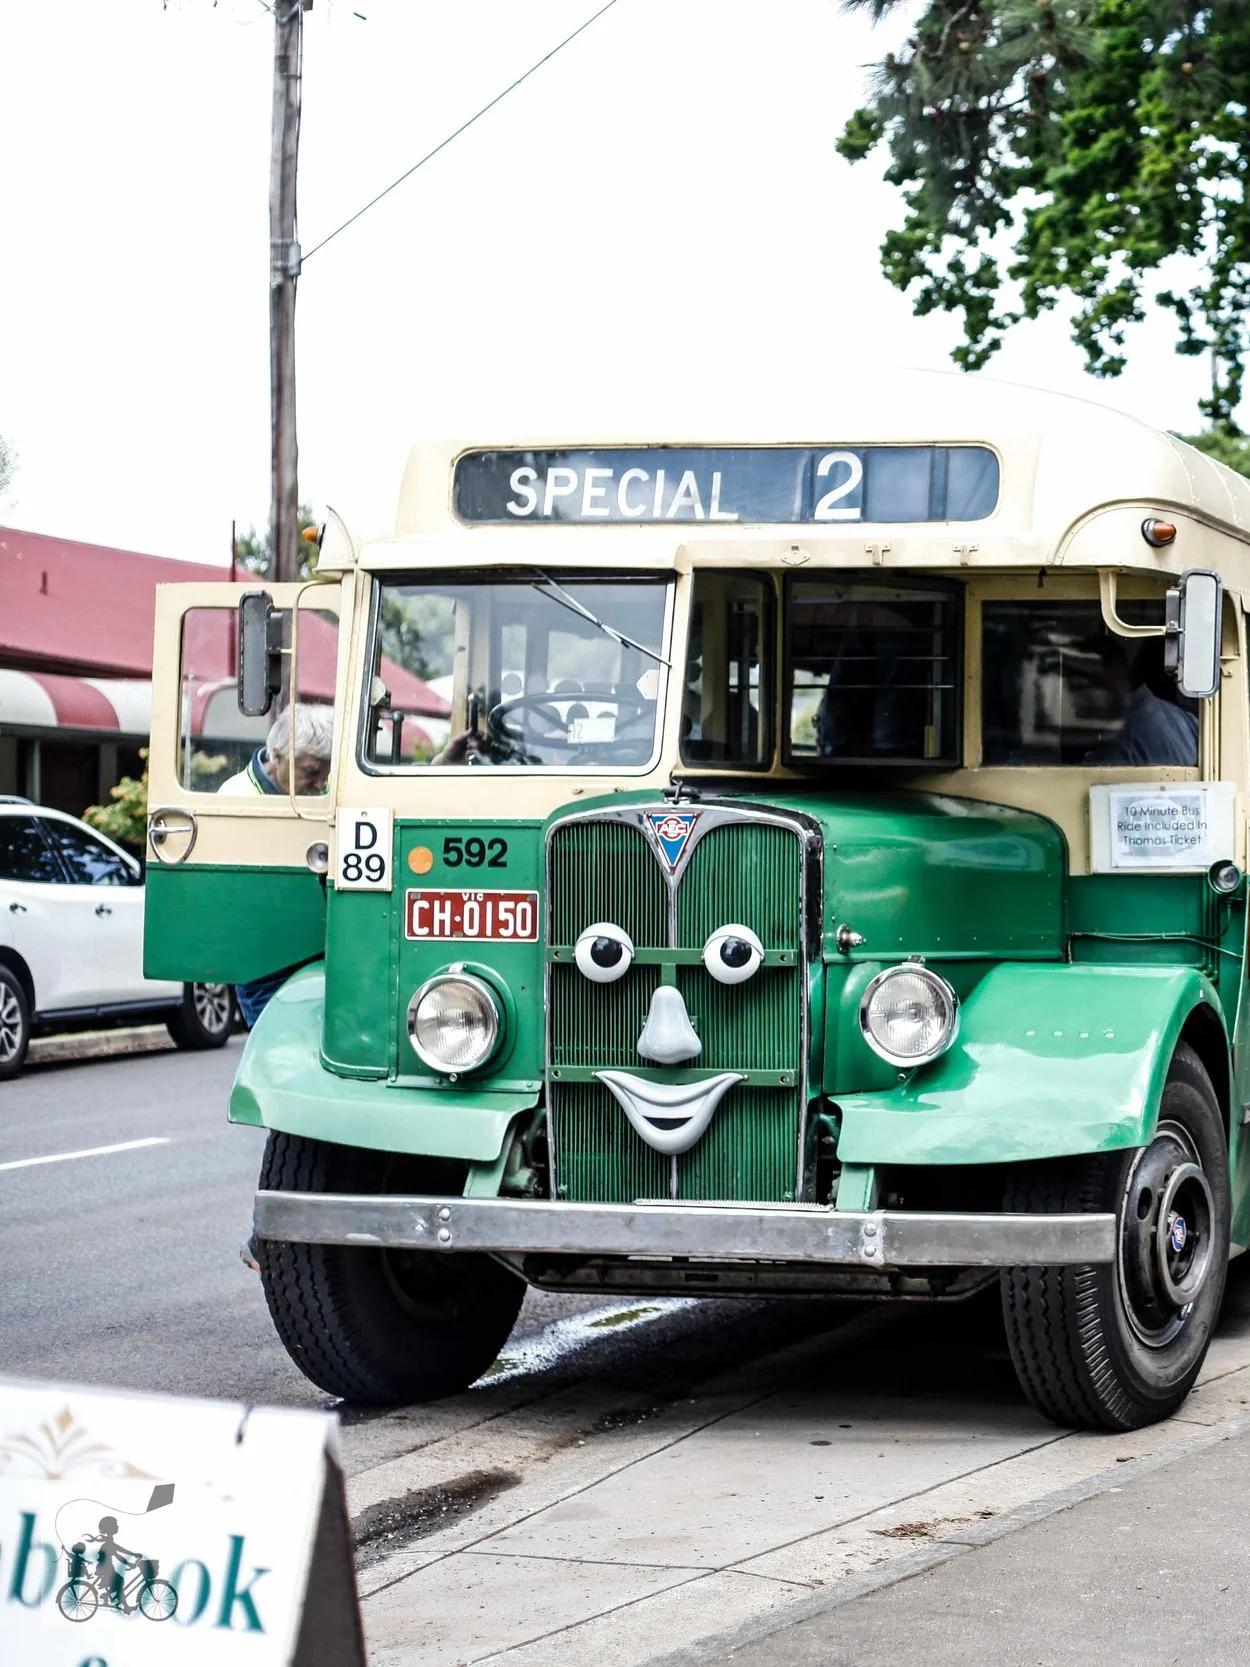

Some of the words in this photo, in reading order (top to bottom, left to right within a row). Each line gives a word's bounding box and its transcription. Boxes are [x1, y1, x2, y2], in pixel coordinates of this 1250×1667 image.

[506, 467, 739, 520] SPECIAL
[813, 451, 864, 520] 2
[1124, 806, 1137, 817] 10
[1139, 806, 1178, 816] Minute
[1181, 805, 1200, 816] Bus
[354, 821, 378, 850] D
[658, 823, 688, 834] AEC
[1117, 821, 1141, 832] Ride
[1144, 820, 1195, 831] Included
[1197, 820, 1208, 830] In
[1123, 835, 1166, 845] Thomas
[1169, 835, 1202, 845] Ticket
[442, 837, 508, 868] 592
[342, 853, 386, 883] 89
[461, 892, 484, 901] VIC
